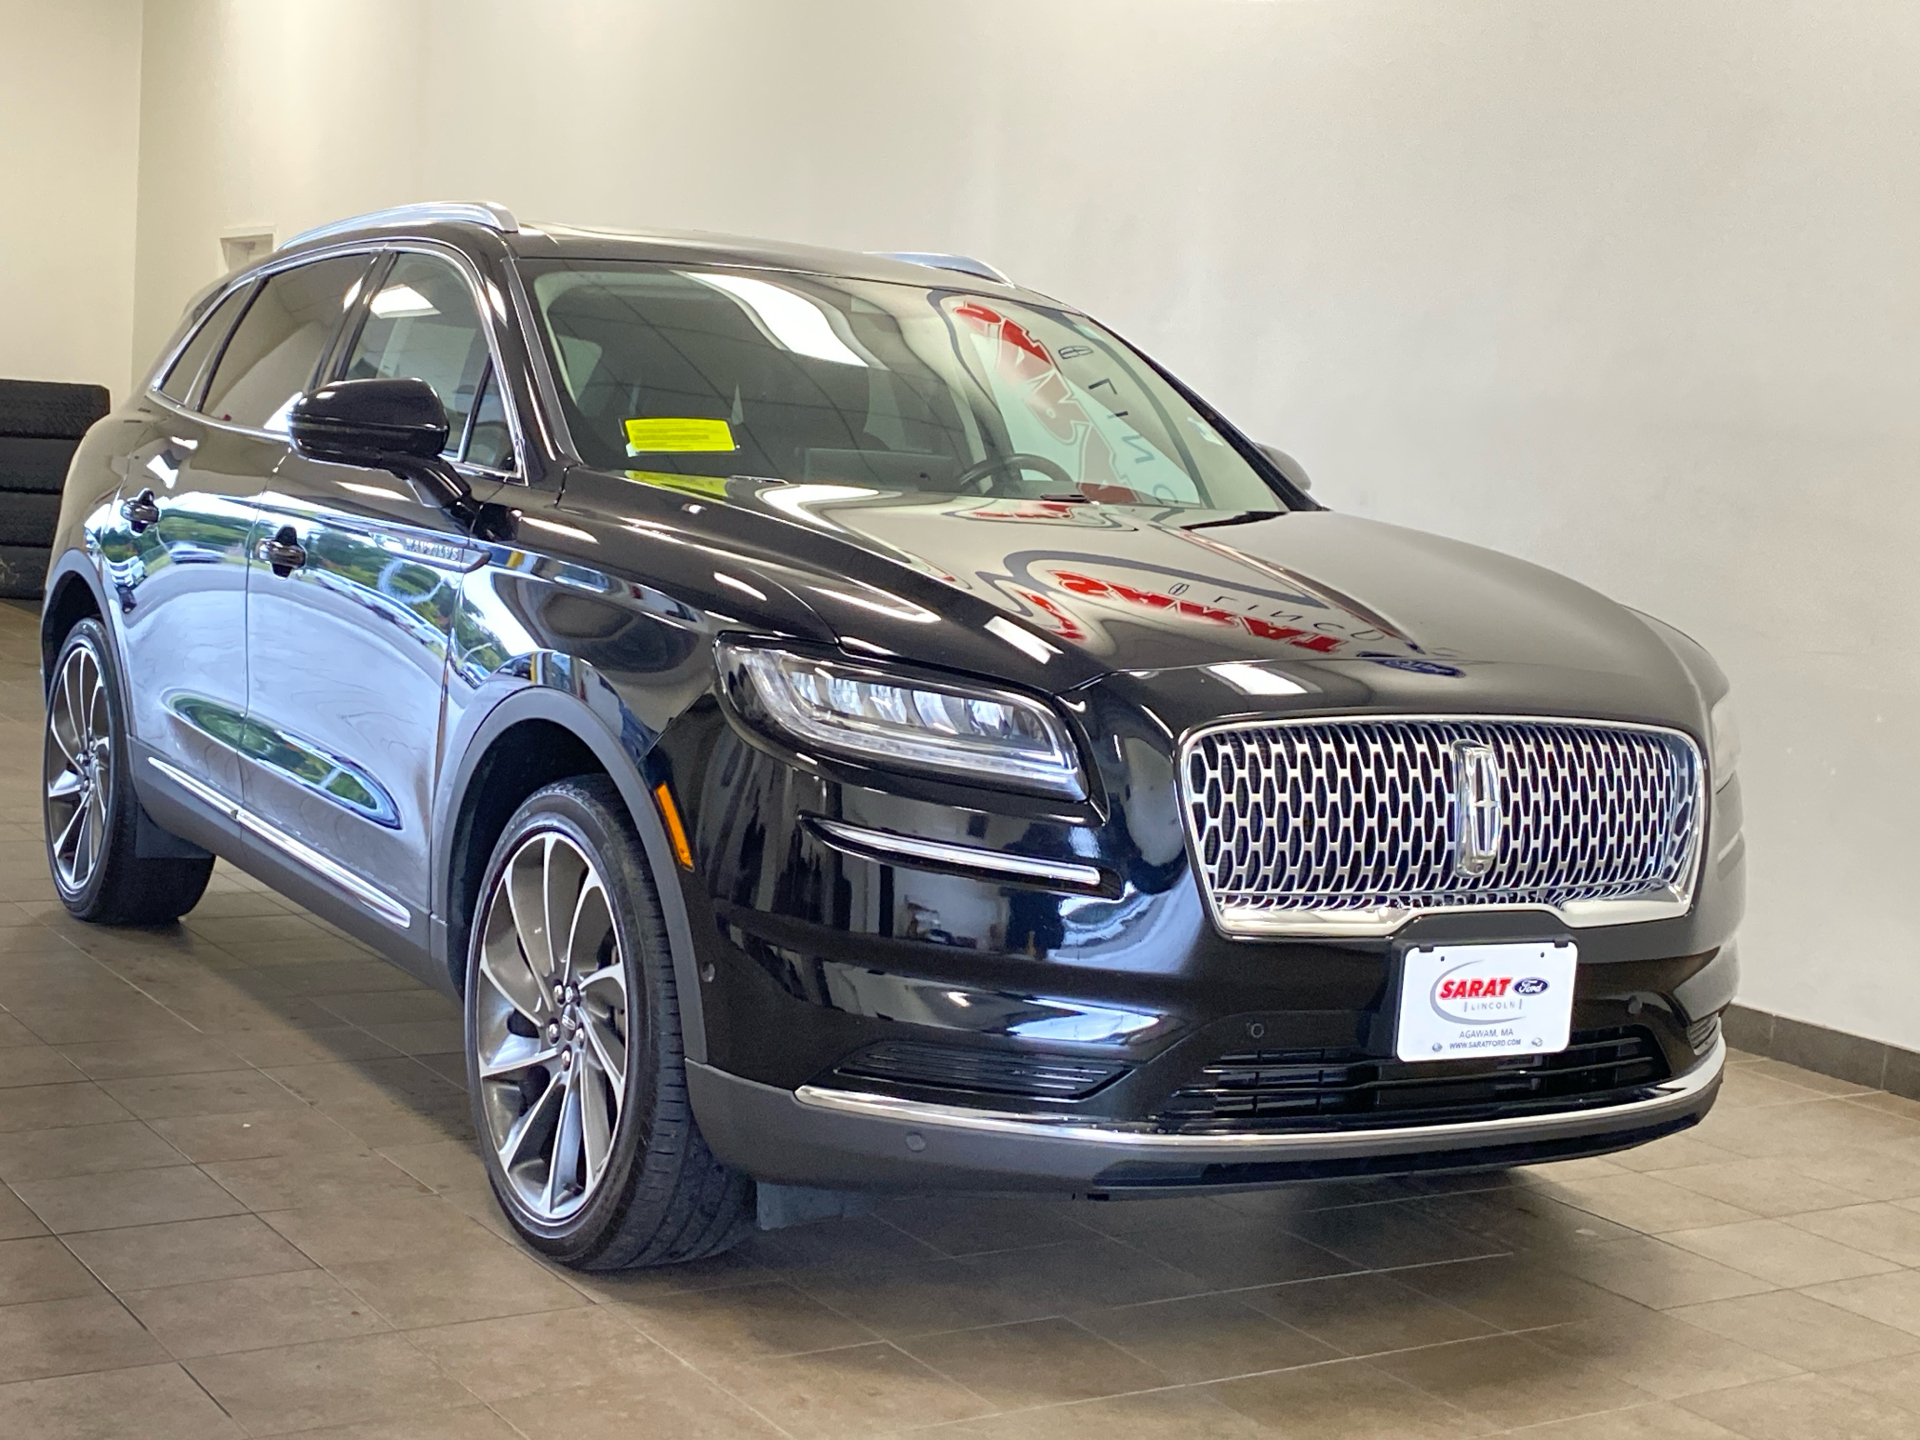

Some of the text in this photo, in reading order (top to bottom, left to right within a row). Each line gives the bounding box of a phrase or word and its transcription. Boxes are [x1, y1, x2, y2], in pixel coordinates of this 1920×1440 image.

[1439, 977, 1545, 1000] SARAT Ford
[1471, 1001, 1515, 1011] LINCOLN
[1459, 1028, 1514, 1039] AGAWAM, MA
[1449, 1039, 1521, 1050] WWW.SARATFORD.COM
